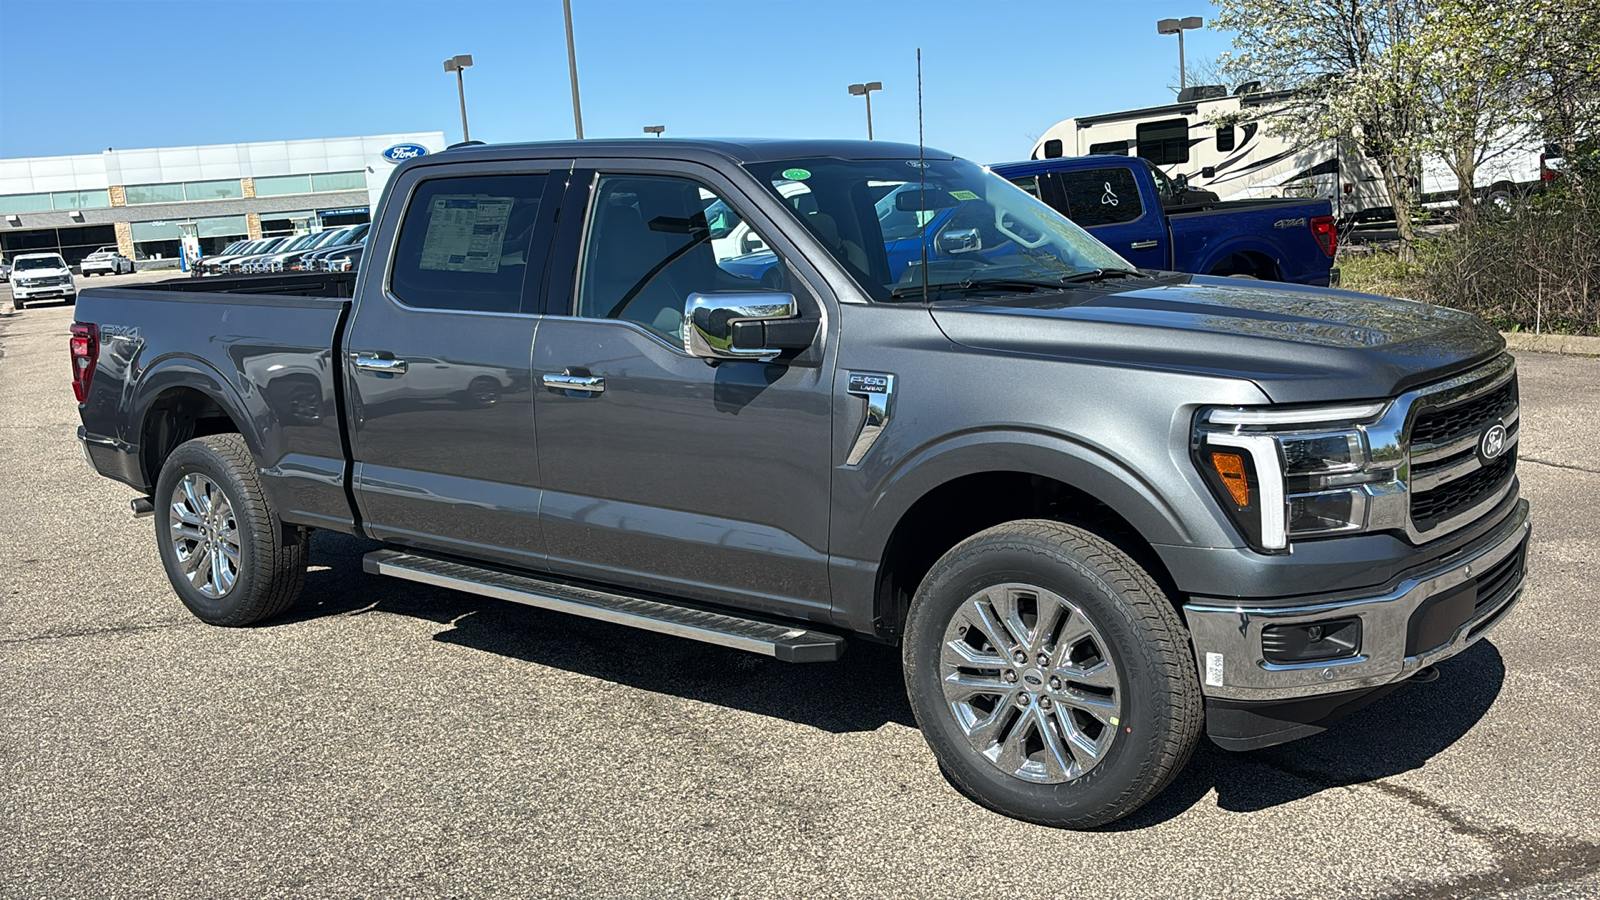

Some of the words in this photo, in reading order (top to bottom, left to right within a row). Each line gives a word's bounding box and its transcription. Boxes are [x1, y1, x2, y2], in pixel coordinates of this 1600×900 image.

[391, 146, 419, 159] Ford
[101, 324, 141, 345] FX4
[850, 375, 887, 386] F-150
[1487, 429, 1504, 455] Ford
